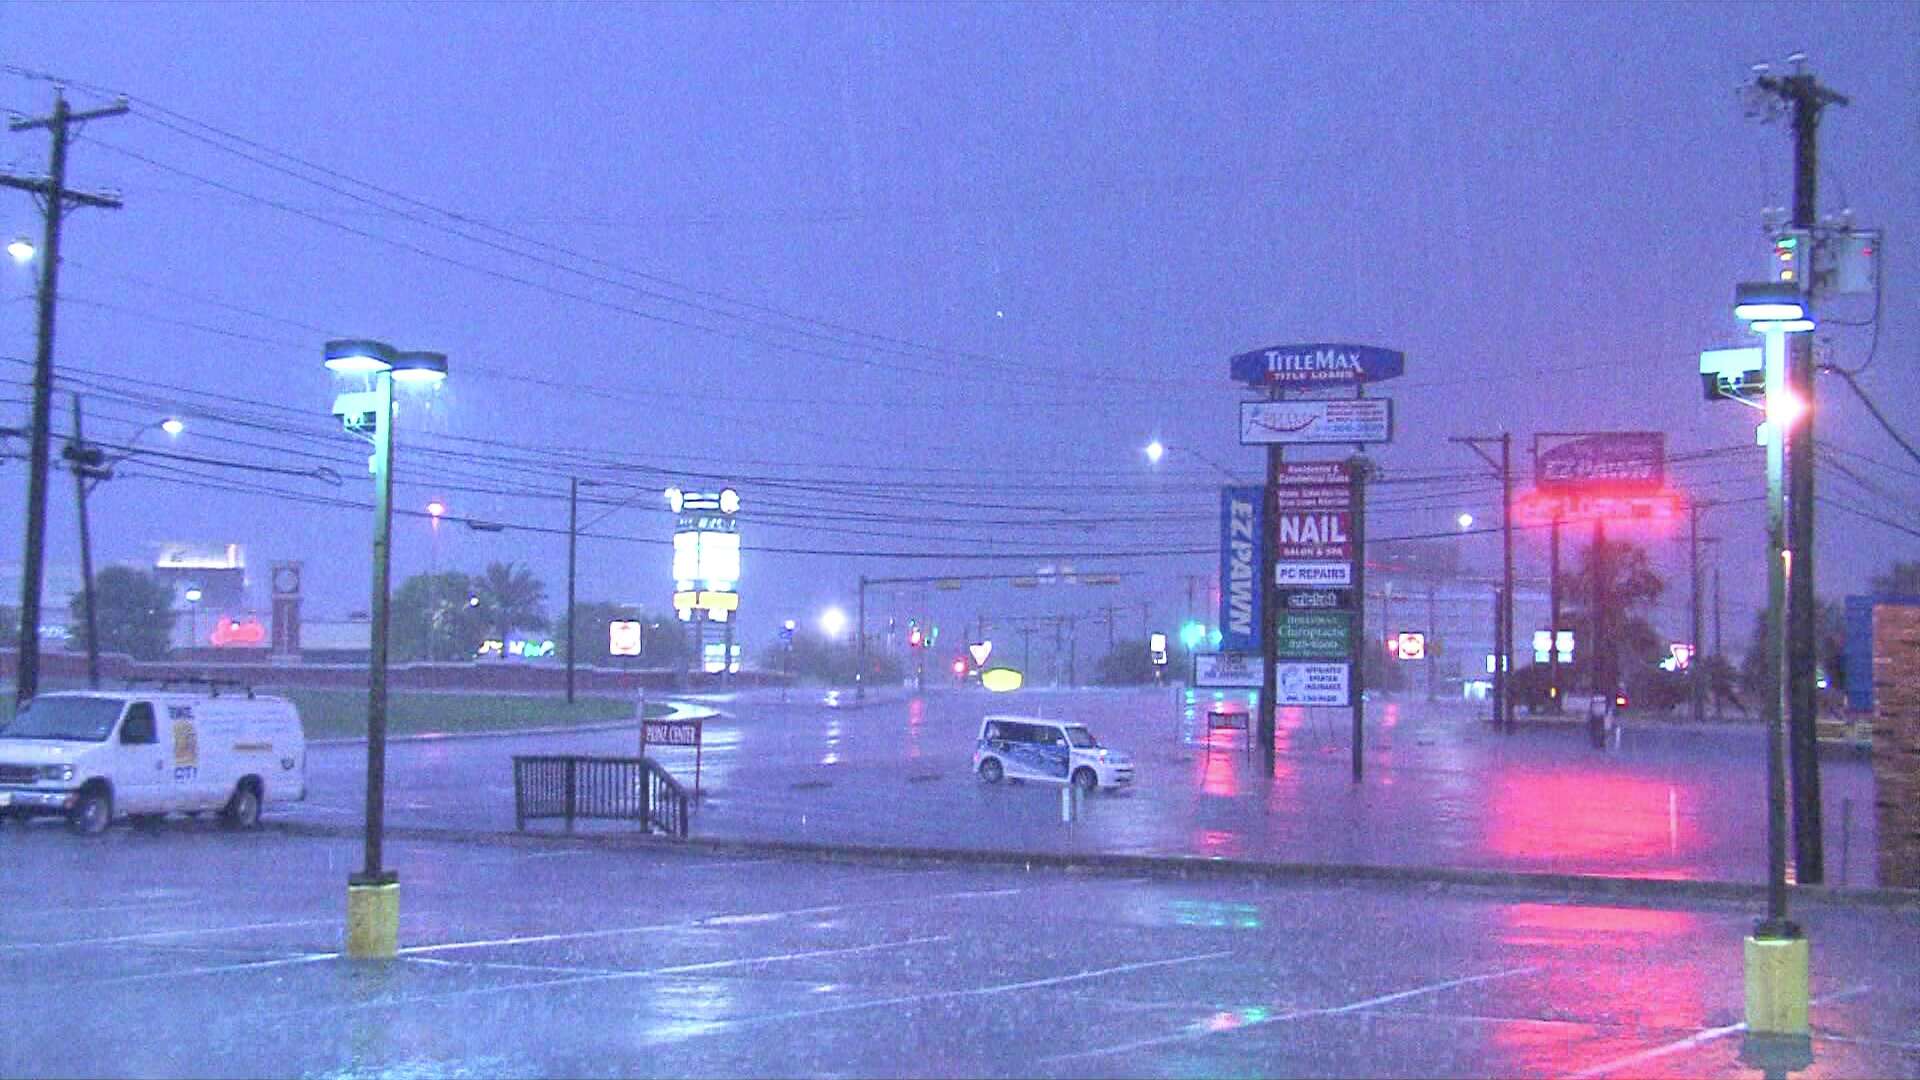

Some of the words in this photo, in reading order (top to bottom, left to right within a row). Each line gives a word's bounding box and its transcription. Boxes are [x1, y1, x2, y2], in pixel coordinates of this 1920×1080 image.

[1311, 371, 1354, 379] LOANS
[1280, 515, 1346, 543] NAIL
[1284, 547, 1313, 556] SALON
[1326, 547, 1343, 556] SPA
[1280, 568, 1296, 578] PC
[1299, 568, 1346, 579] REPAIRS
